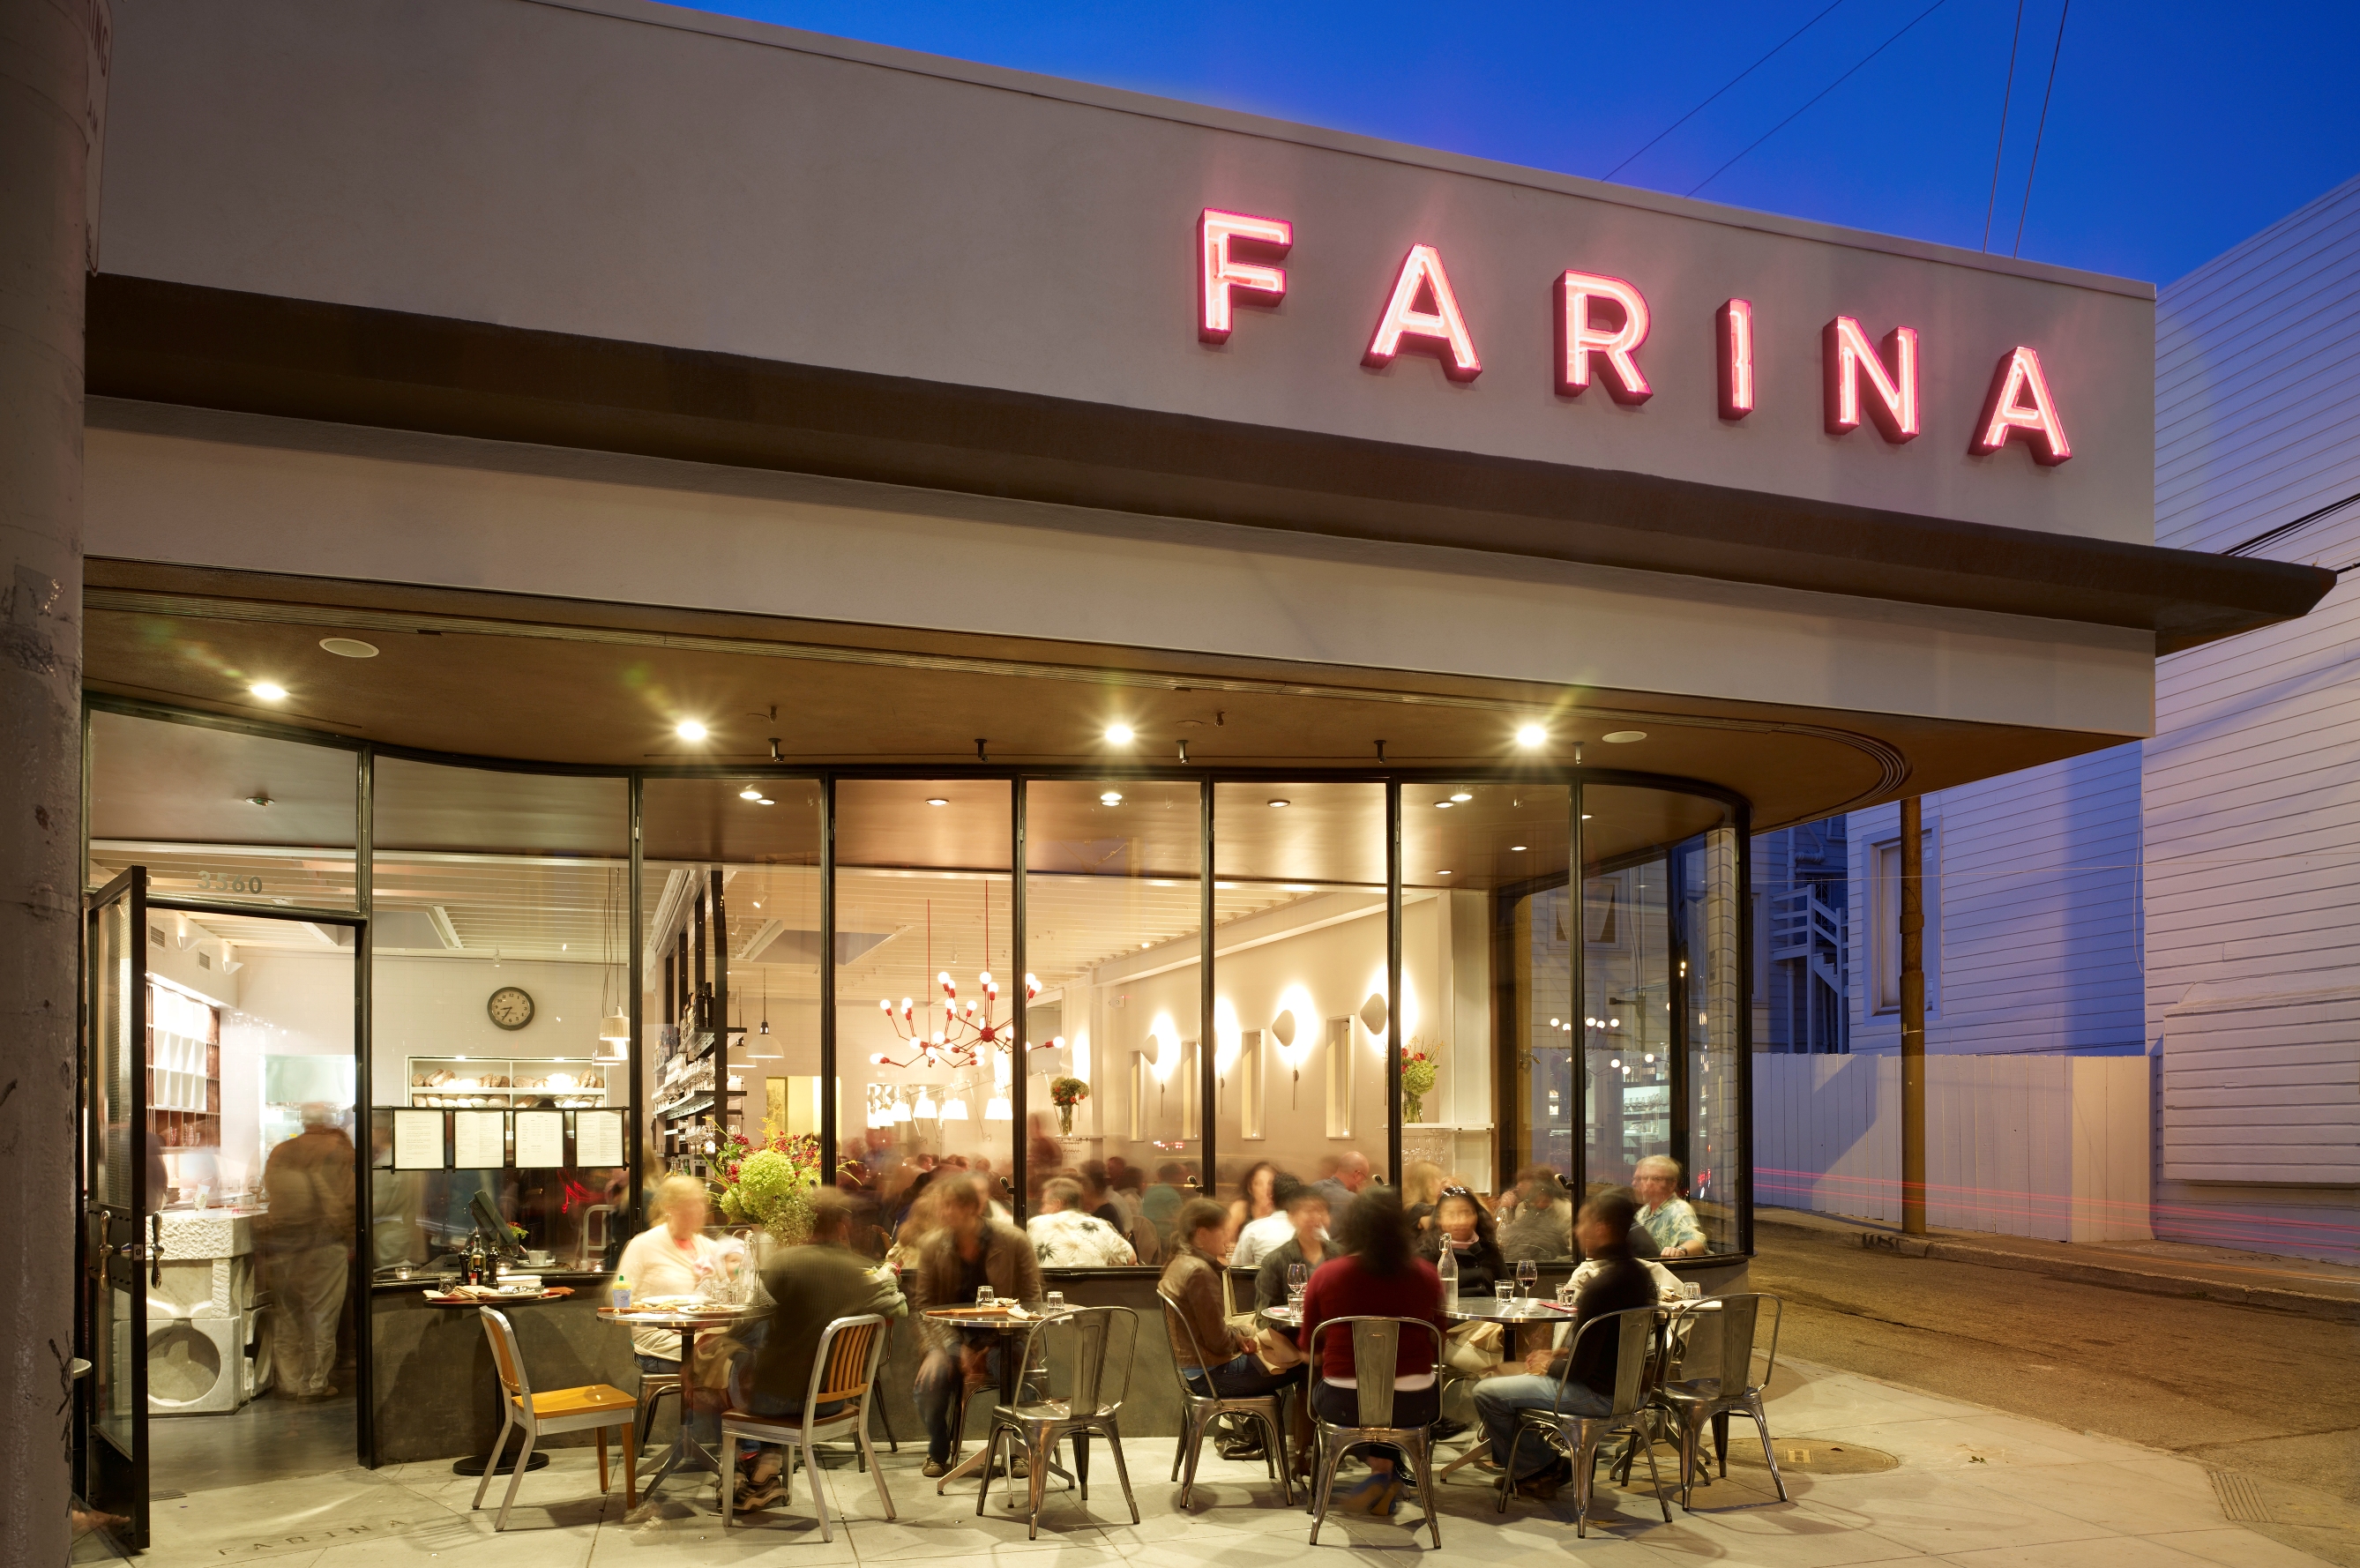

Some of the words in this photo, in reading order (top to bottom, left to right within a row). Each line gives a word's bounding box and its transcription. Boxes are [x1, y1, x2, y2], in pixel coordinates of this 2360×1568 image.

[1198, 208, 2072, 467] FARINA
[197, 870, 263, 894] 3560
[218, 1519, 407, 1556] FARINA
